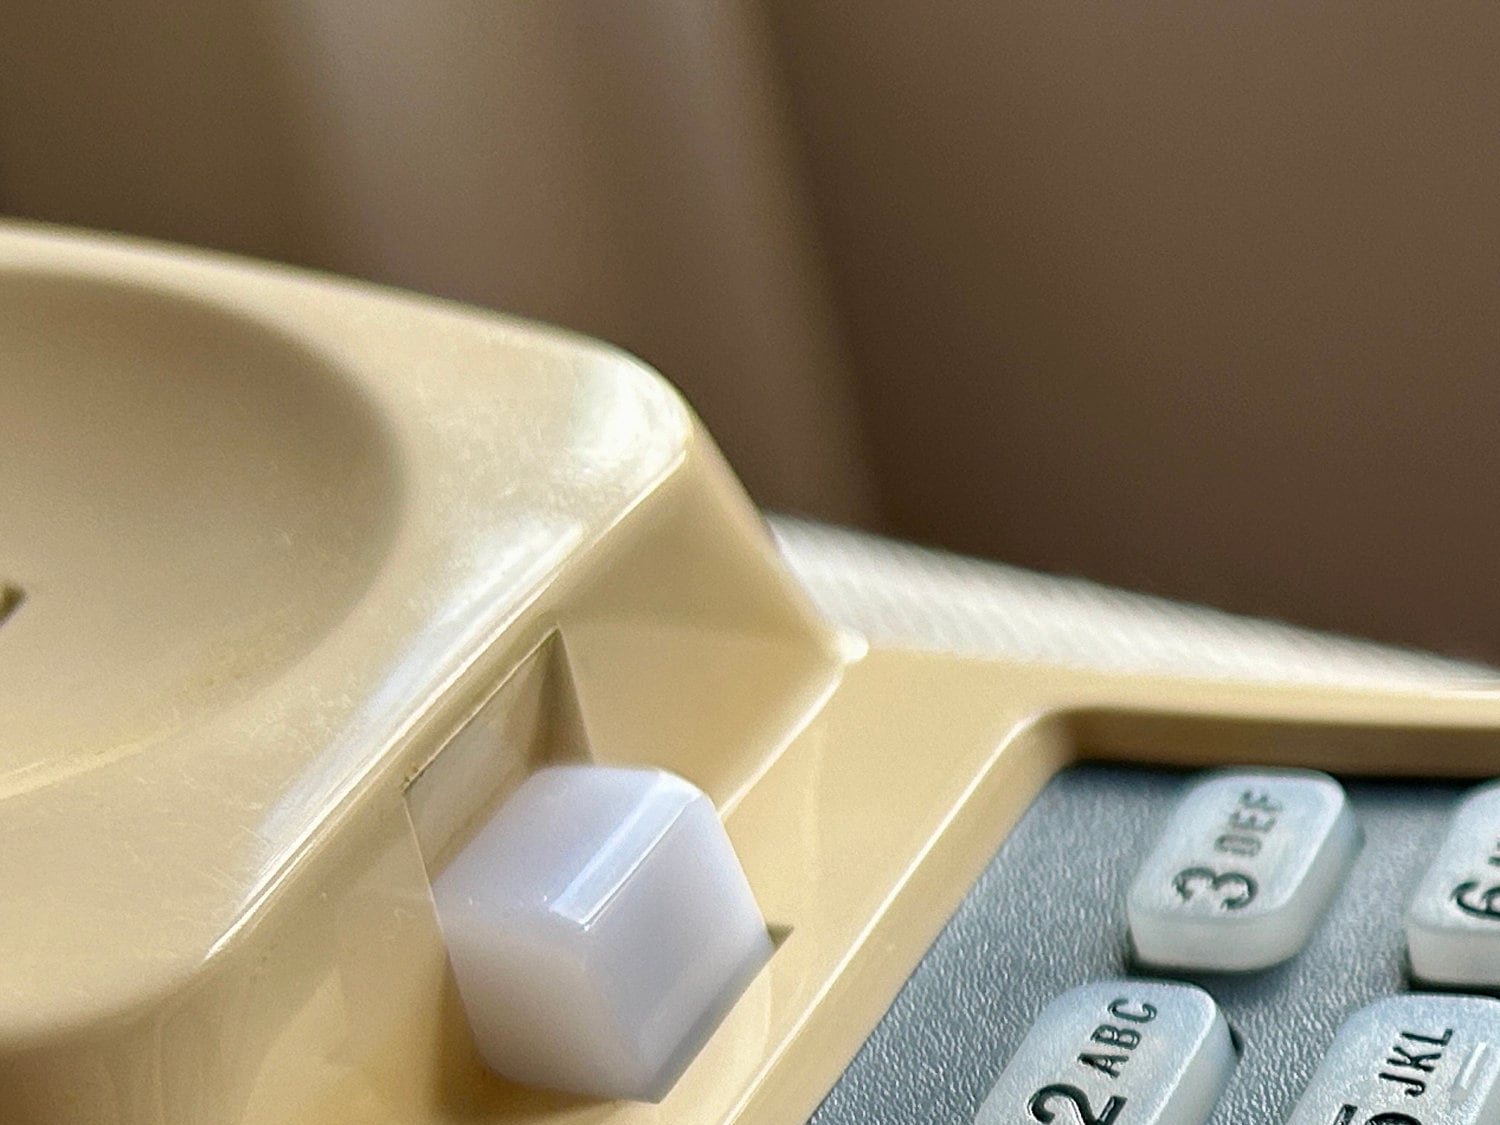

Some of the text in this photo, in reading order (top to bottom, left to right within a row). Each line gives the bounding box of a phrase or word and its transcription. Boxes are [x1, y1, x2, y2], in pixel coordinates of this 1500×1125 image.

[1172, 789, 1284, 911] 3 DEF
[1077, 998, 1158, 1080] ABC
[1378, 1026, 1454, 1098] JKL
